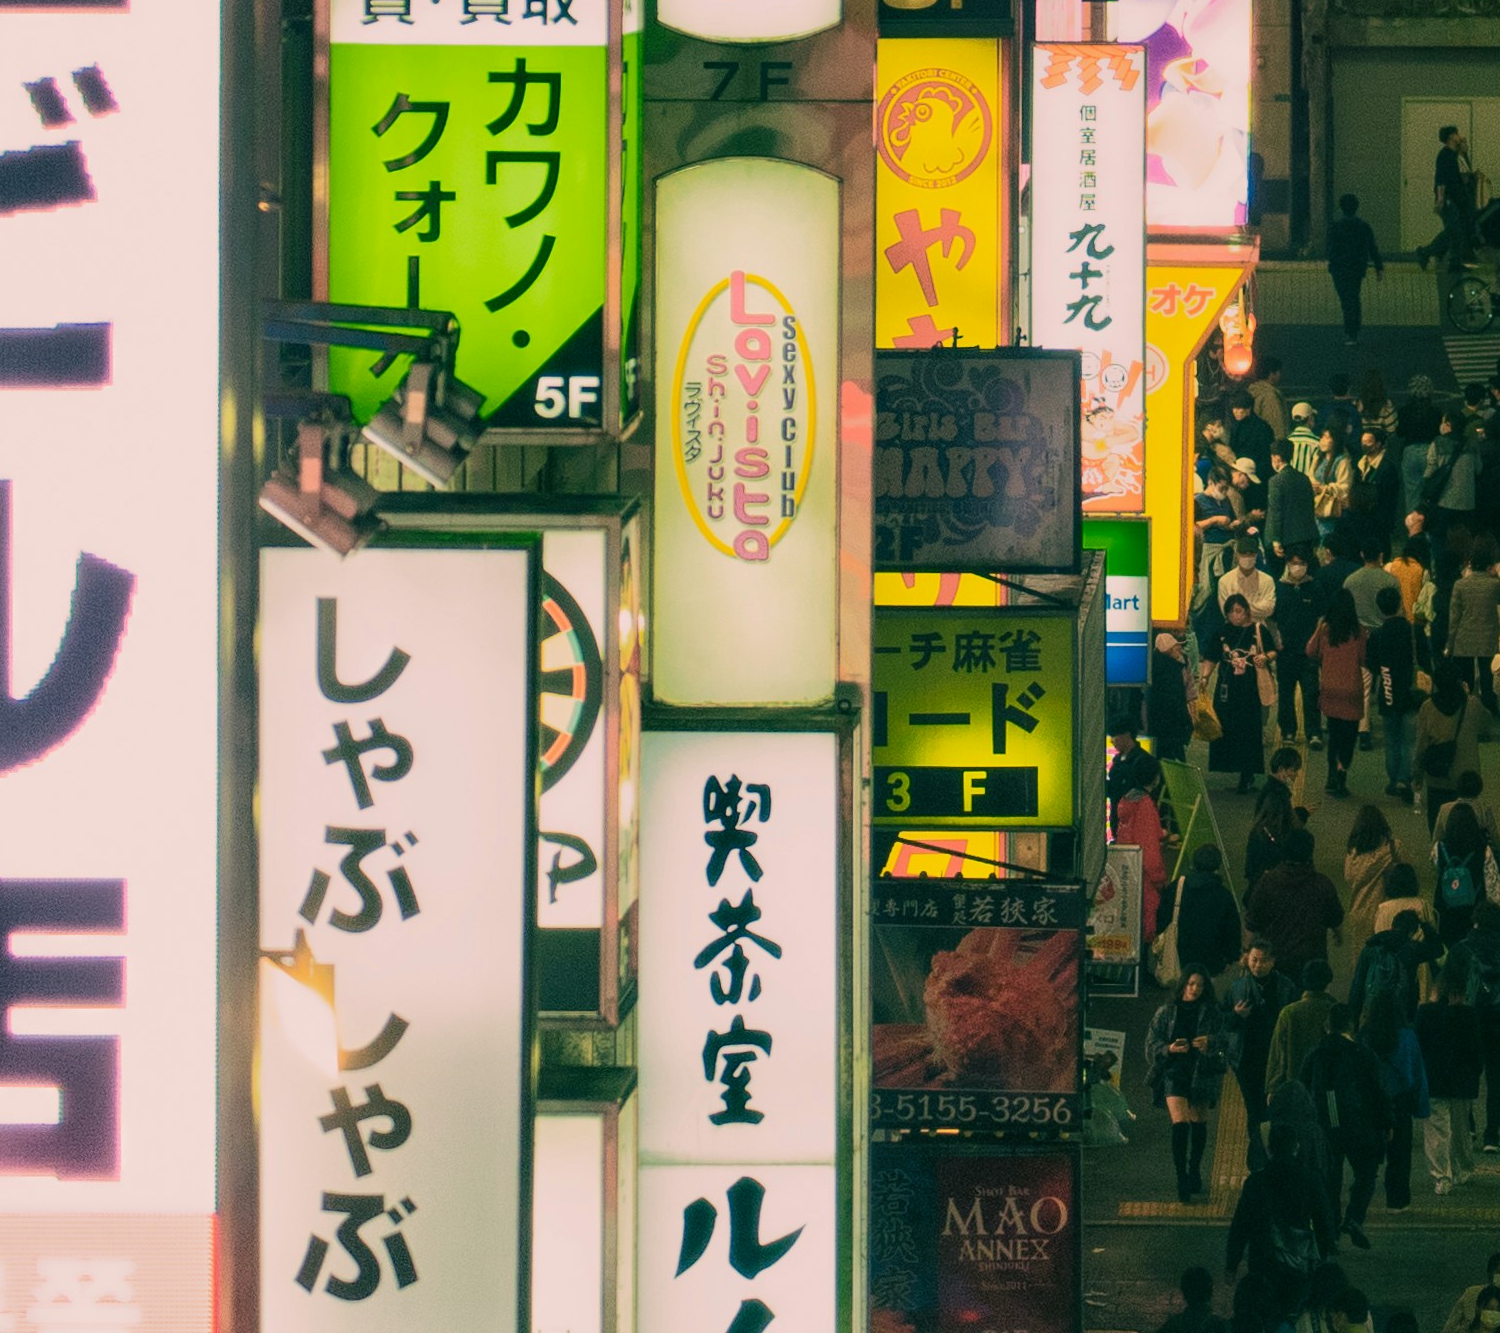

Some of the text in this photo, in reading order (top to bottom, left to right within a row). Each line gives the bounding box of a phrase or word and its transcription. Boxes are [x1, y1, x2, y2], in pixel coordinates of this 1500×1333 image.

[705, 61, 793, 101] 7F
[1079, 104, 1098, 211] 個室居酒屋
[1064, 222, 1115, 332] 九十九
[534, 375, 600, 419] 5F
[781, 316, 797, 411] Sexy
[706, 353, 729, 521] Shinjuku
[730, 269, 777, 562] Lavista
[693, 773, 782, 1126] 喫茶室
[941, 1195, 1070, 1236] MAO
[958, 1237, 1051, 1262] ANNEX
